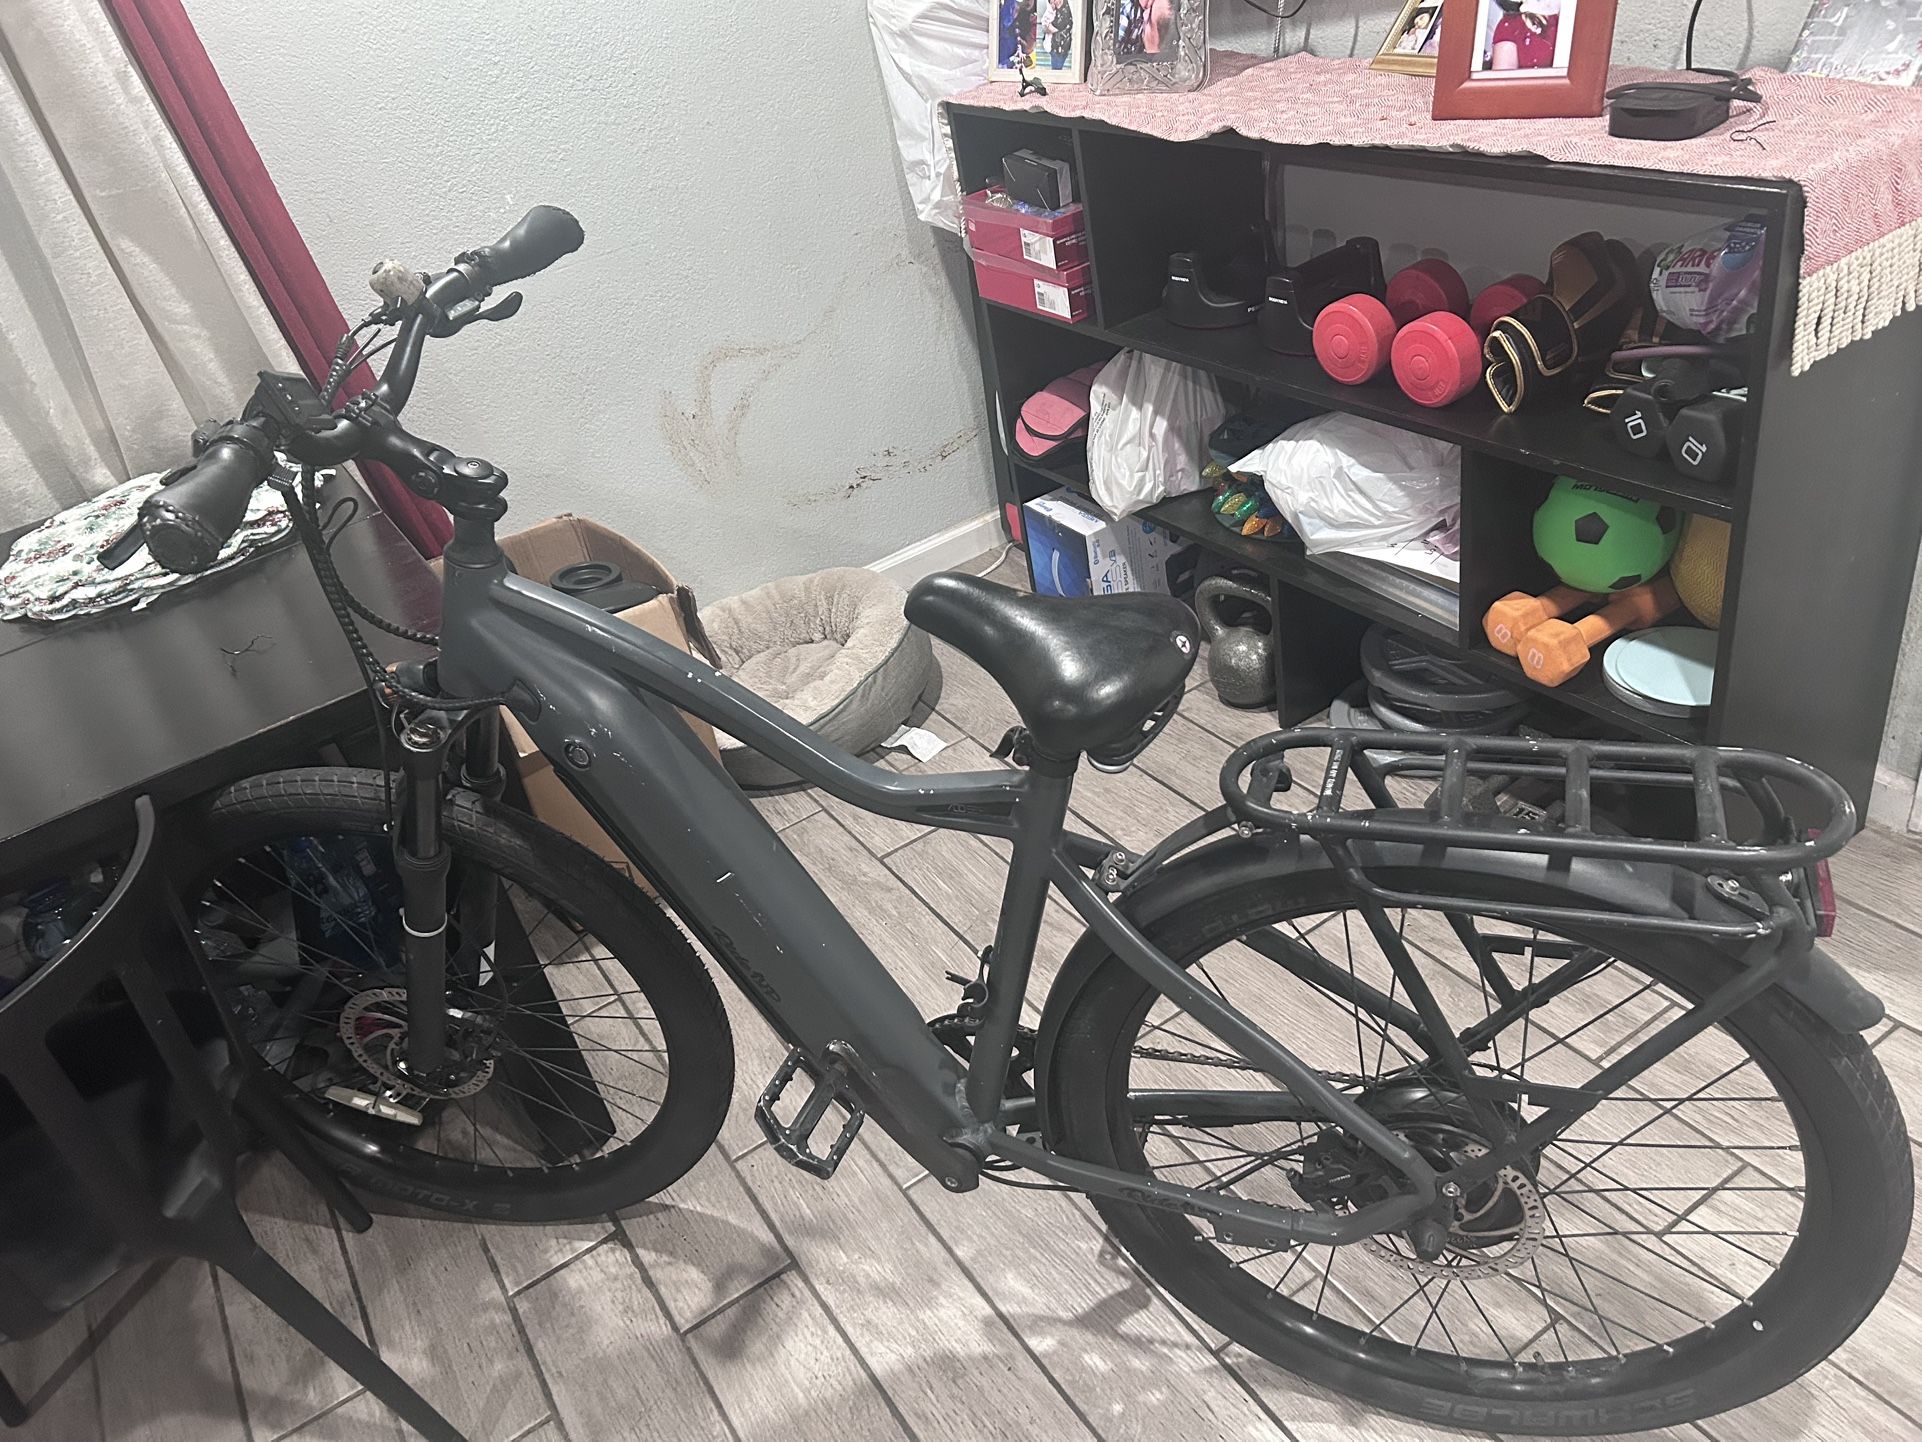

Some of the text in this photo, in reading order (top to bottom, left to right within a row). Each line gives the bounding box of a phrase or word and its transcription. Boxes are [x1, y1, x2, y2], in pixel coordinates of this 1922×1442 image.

[1625, 410, 1648, 440] 10
[1681, 435, 1707, 467] 10
[1122, 562, 1131, 586] SPEAKER
[1494, 623, 1511, 644] 8
[1527, 647, 1544, 669] 8
[1417, 1387, 1698, 1427] SCHWALBE
